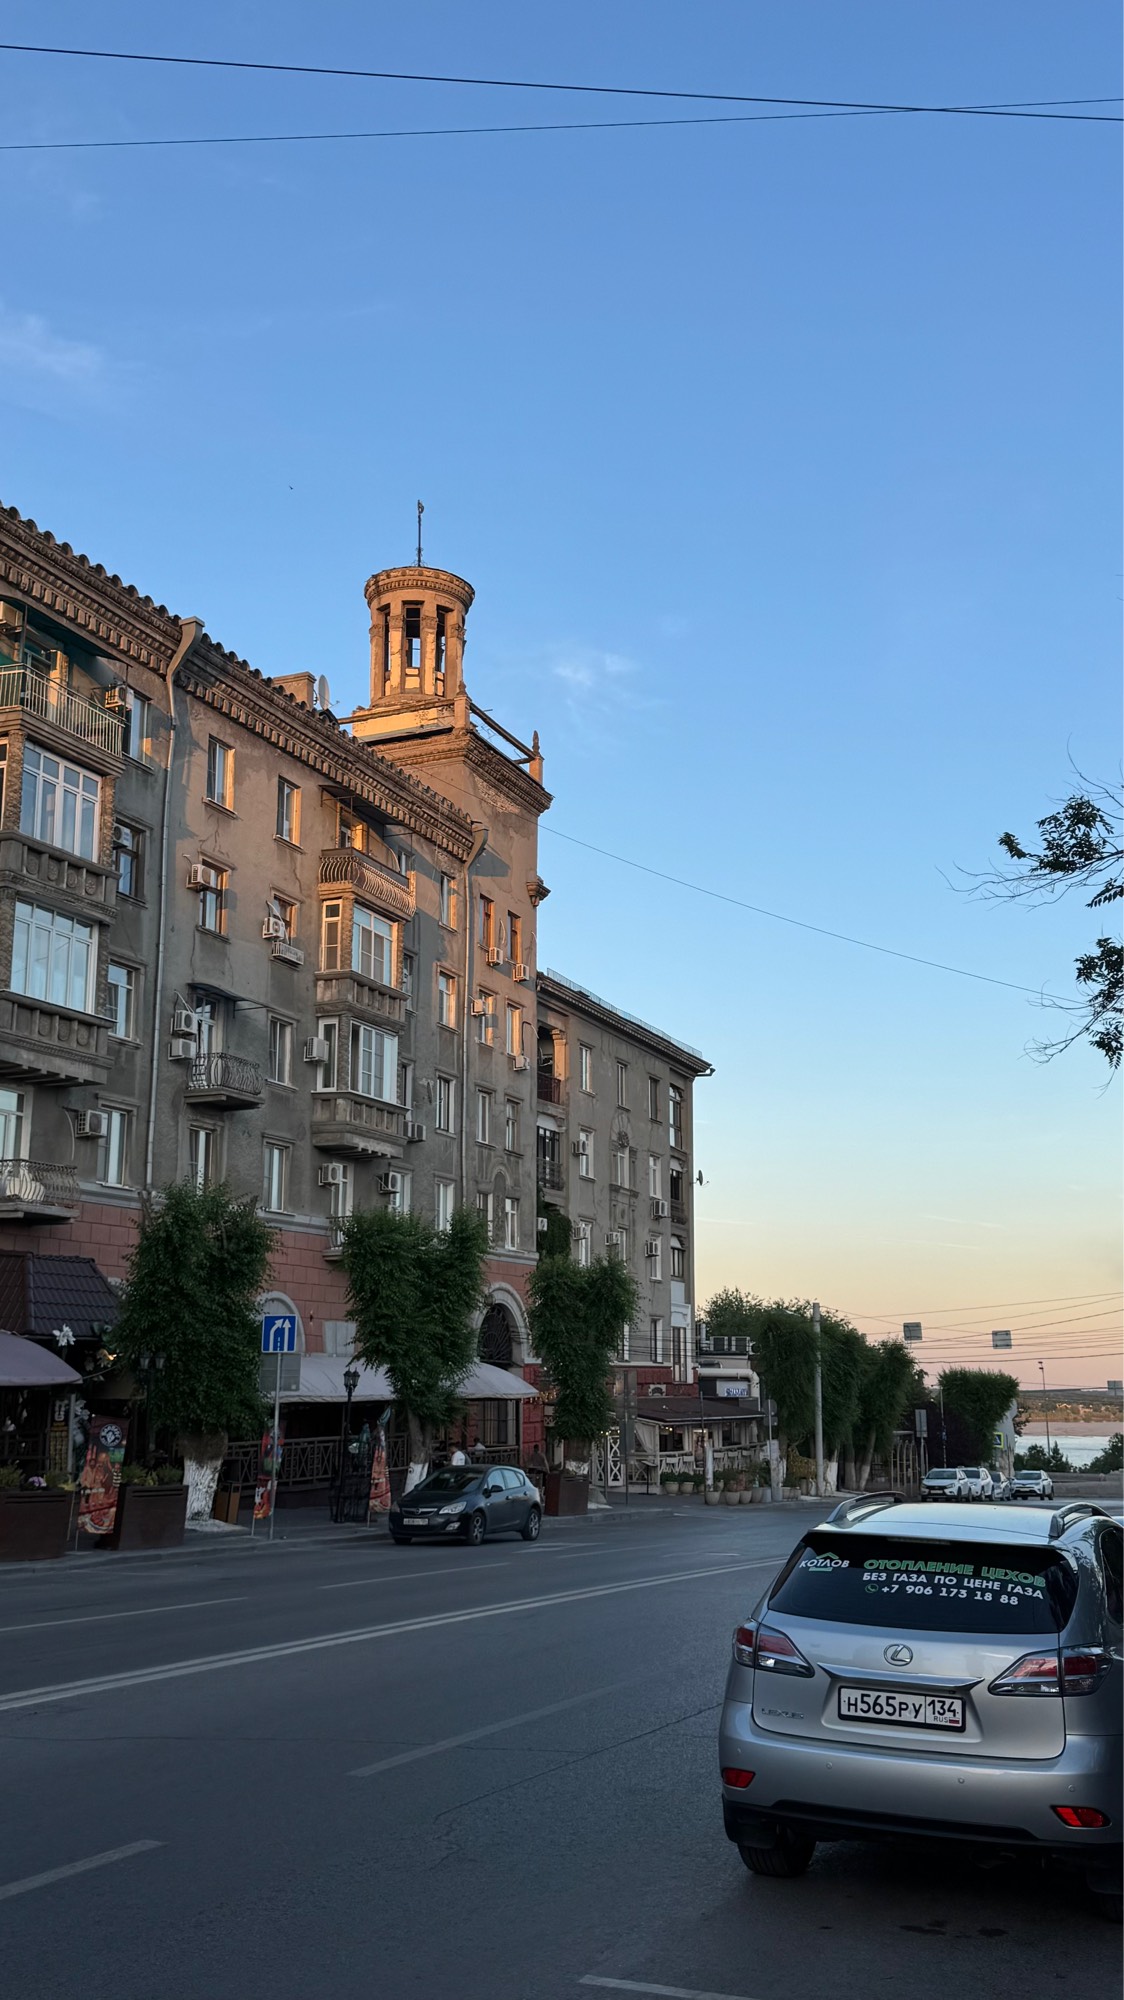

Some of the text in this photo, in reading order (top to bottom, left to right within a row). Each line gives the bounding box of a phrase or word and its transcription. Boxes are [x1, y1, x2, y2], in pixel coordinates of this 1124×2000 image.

[799, 1559, 850, 1568] КОТЛОВ
[863, 1559, 1046, 1587] ОТОПЛЕНИЕ ЦЕХОВ
[862, 1572, 1044, 1599] БЕЗ ГАЗА ПО ЦЕНЕ ГАЗА
[881, 1584, 1019, 1605] +7 906 173 18 88
[847, 1693, 957, 1719] Н565РУ 134
[933, 1715, 949, 1723] RUS
